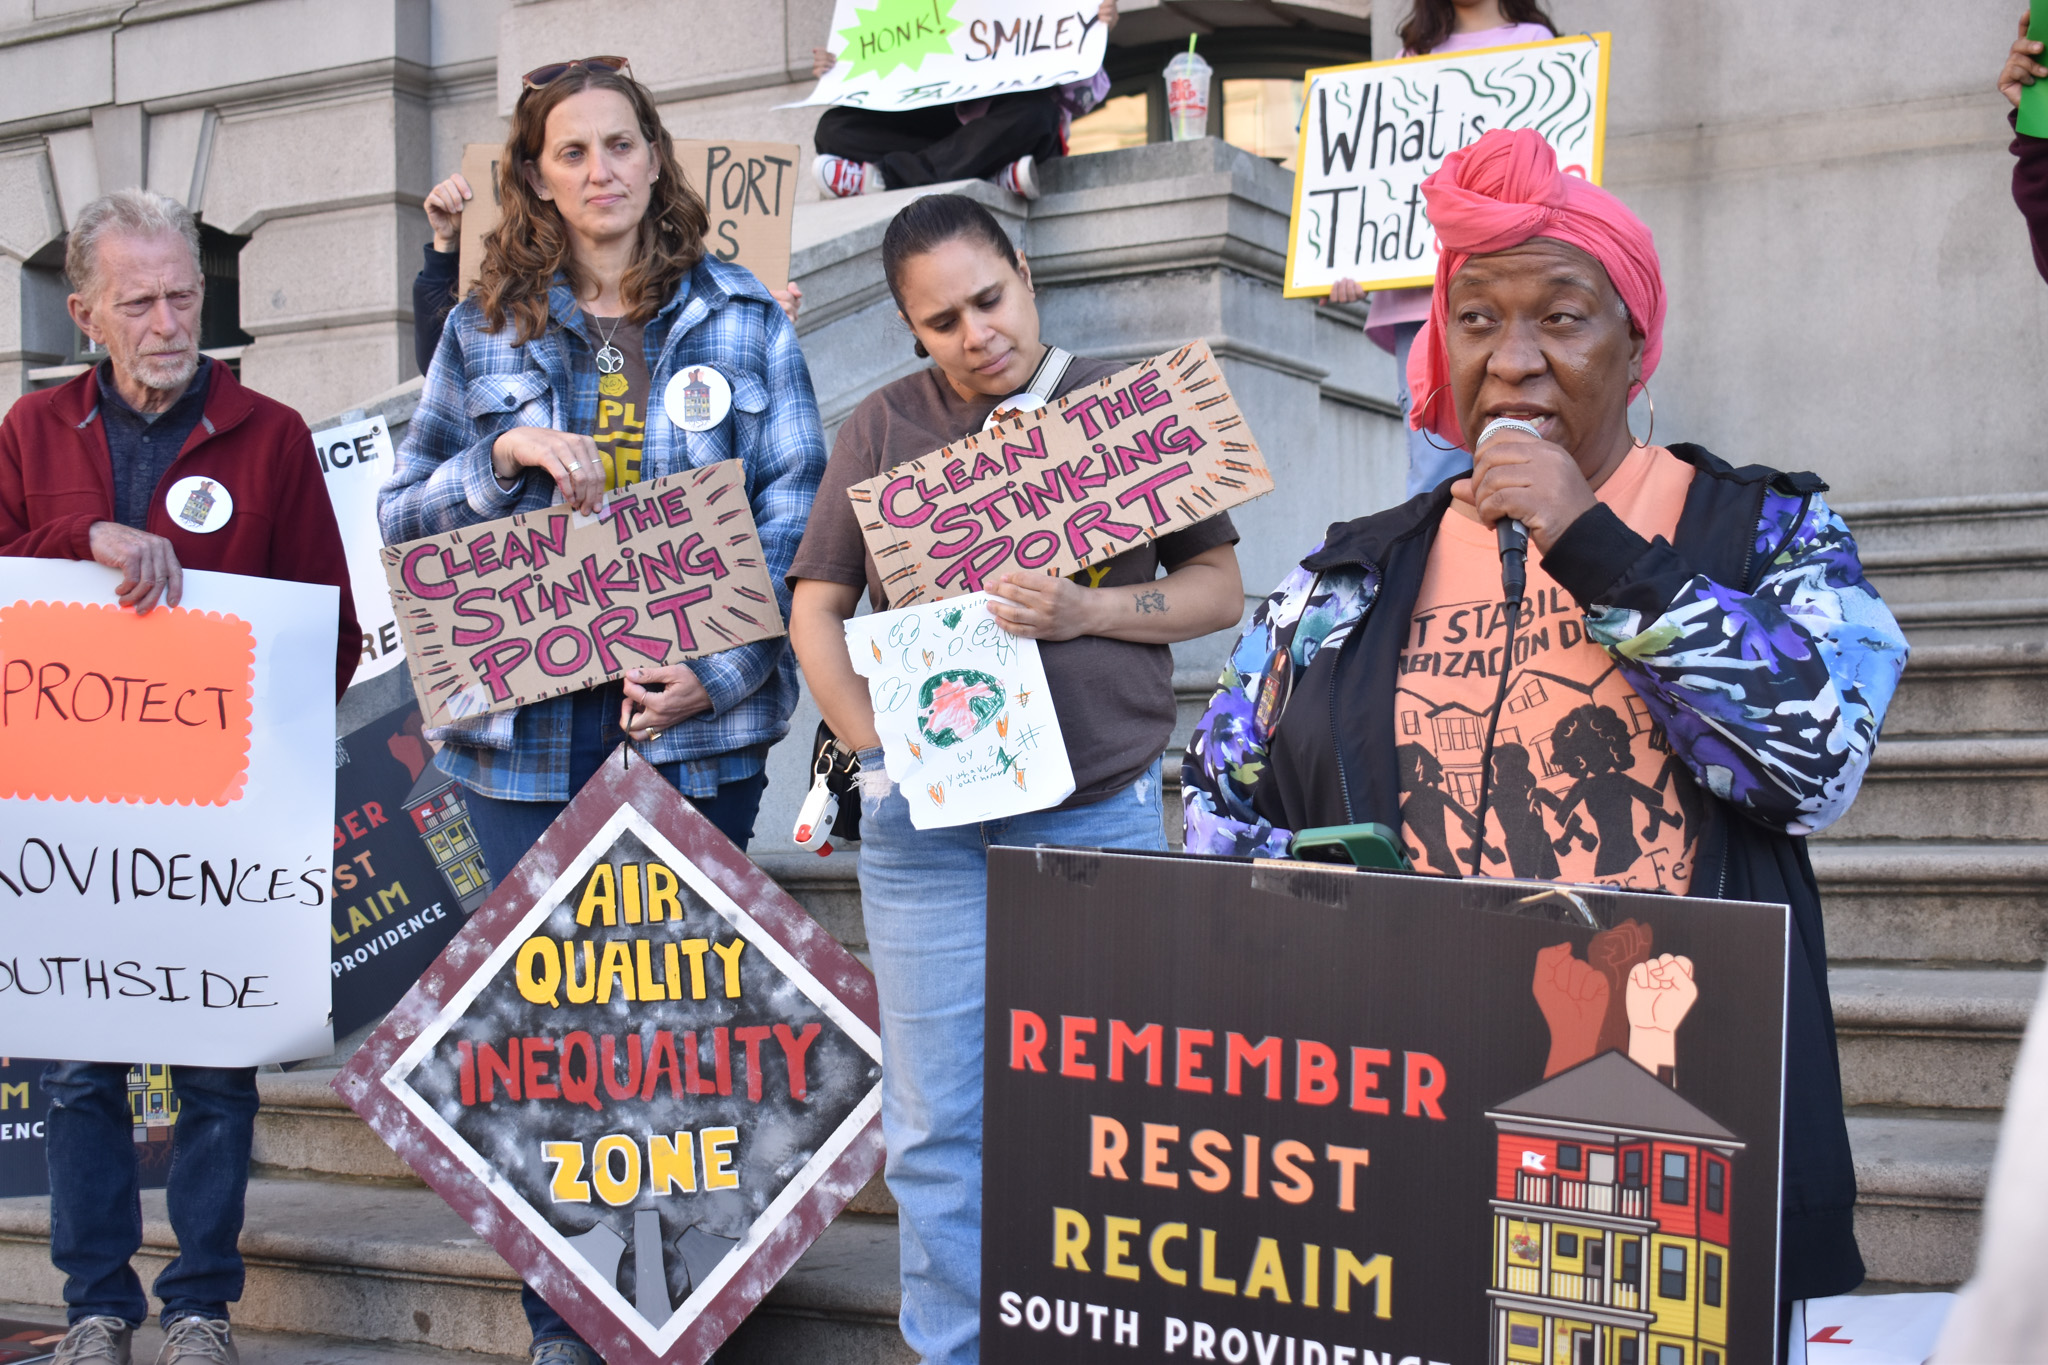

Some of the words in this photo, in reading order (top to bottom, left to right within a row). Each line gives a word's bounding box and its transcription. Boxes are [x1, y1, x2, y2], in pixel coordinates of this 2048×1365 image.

[859, 0, 947, 59] HONK!
[965, 11, 1101, 61] SMILEY
[1319, 82, 1445, 176] What
[706, 145, 793, 217] PORT
[1308, 183, 1425, 268] That
[879, 426, 1049, 529] CLEAN
[1061, 368, 1173, 440] THE
[401, 514, 569, 600] CLEAN
[598, 486, 691, 545] THE
[935, 461, 1194, 594] PORT
[469, 584, 713, 704] PORT
[1442, 586, 1581, 645] STABIL
[2, 658, 234, 731] PROTECT
[575, 862, 684, 928] AIR
[331, 902, 447, 978] PROVIDENCE
[515, 935, 746, 1010] QUALITY
[457, 1022, 822, 1112] INEQUALITY
[1009, 1008, 1448, 1120] REMEMBER
[540, 1126, 740, 1207] ZONE
[1089, 1114, 1370, 1212] RESIST
[1052, 1206, 1394, 1320] RECLAIM
[999, 1290, 1140, 1347] SOUTH
[1164, 1315, 1453, 1365] PROVIDE
